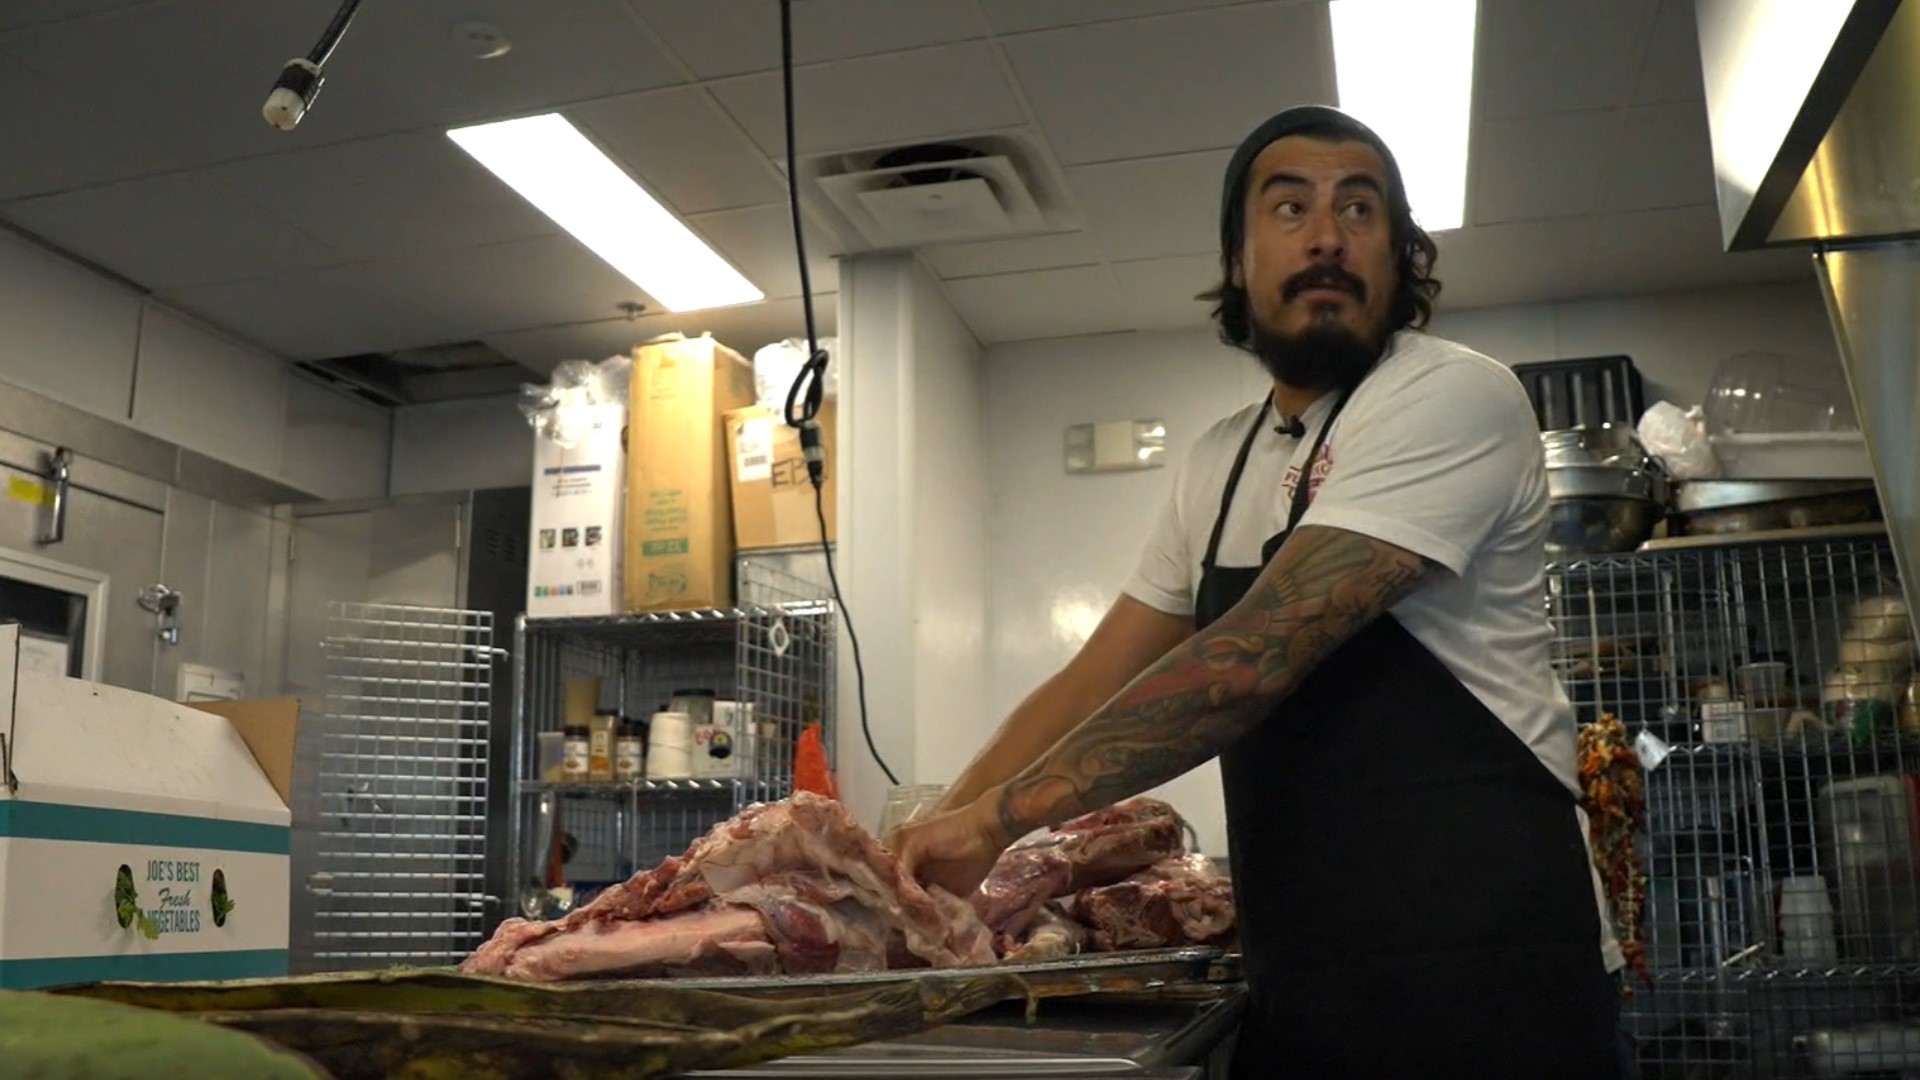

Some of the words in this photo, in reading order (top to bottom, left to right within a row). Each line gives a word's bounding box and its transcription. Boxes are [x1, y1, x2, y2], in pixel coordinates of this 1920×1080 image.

[146, 859, 174, 881] JOE'S
[176, 861, 201, 882] BEST
[158, 886, 191, 910] Fresh
